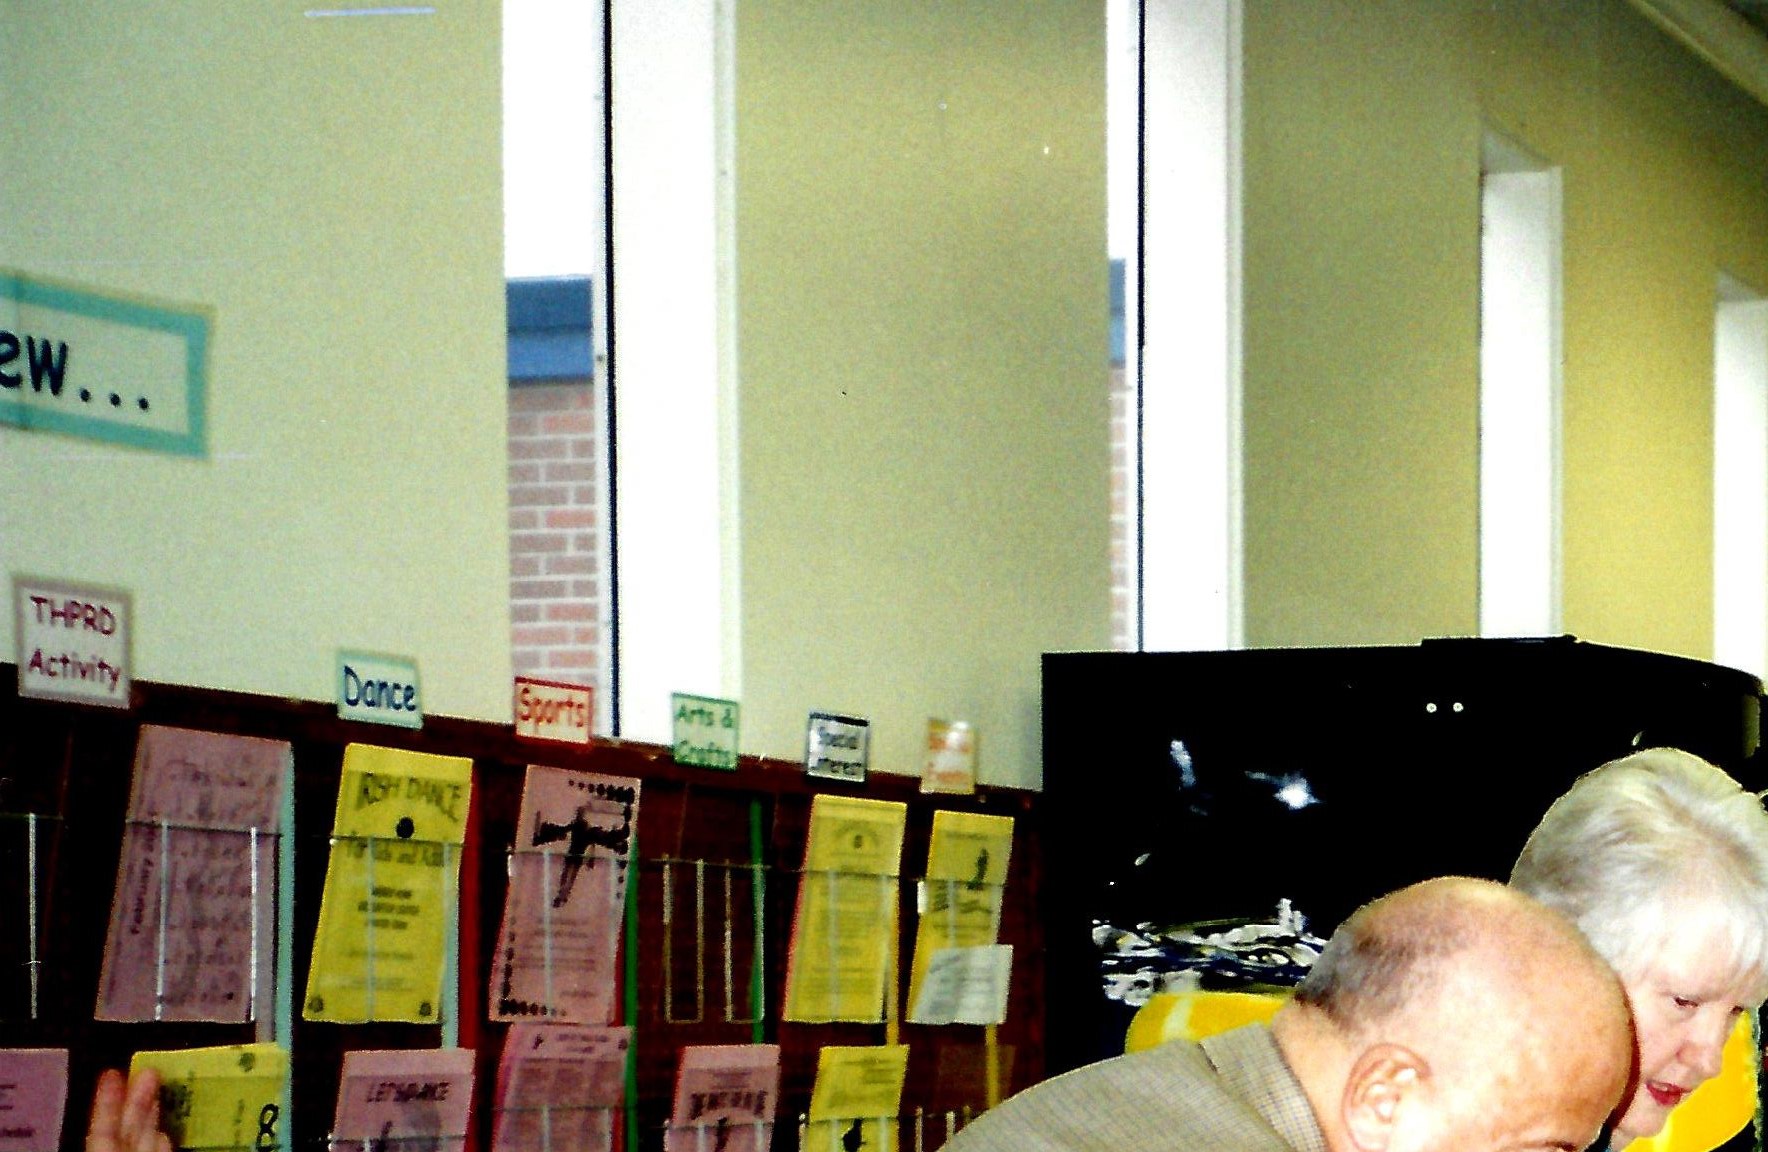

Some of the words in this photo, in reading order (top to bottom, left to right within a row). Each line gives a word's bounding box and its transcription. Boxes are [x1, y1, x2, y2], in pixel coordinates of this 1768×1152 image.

[30, 596, 117, 636] THPRD
[28, 648, 121, 693] Activity
[344, 665, 417, 713] Dance
[520, 687, 585, 734] Sports
[676, 704, 715, 727] Arts
[676, 739, 732, 766] Crafts
